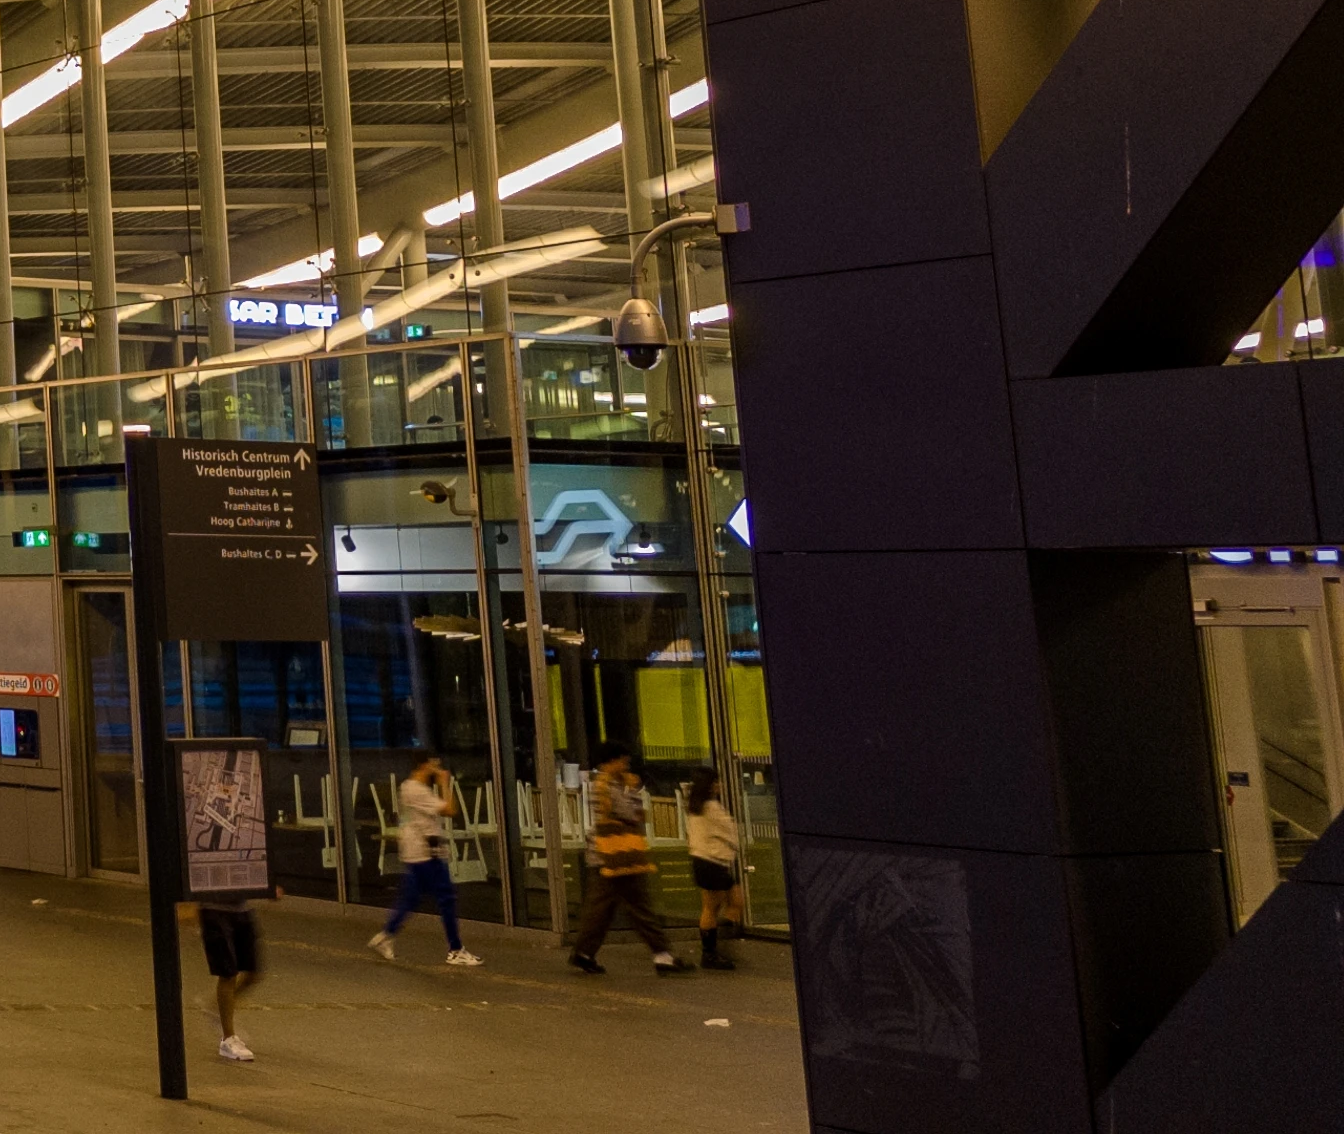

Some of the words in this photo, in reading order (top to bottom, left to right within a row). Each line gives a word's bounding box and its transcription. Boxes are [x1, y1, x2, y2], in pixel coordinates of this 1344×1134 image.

[182, 448, 239, 462] Historisch
[242, 450, 290, 464] Centrum
[196, 465, 292, 482] Vredenburgplein
[228, 486, 270, 497] Bushaltes
[271, 487, 279, 497] A
[223, 501, 272, 512] Tramhaltes
[274, 503, 280, 512] B
[210, 516, 235, 528] Hoog
[236, 517, 281, 529] Catharijne
[221, 548, 263, 559] Bushaltes
[275, 550, 282, 559] D
